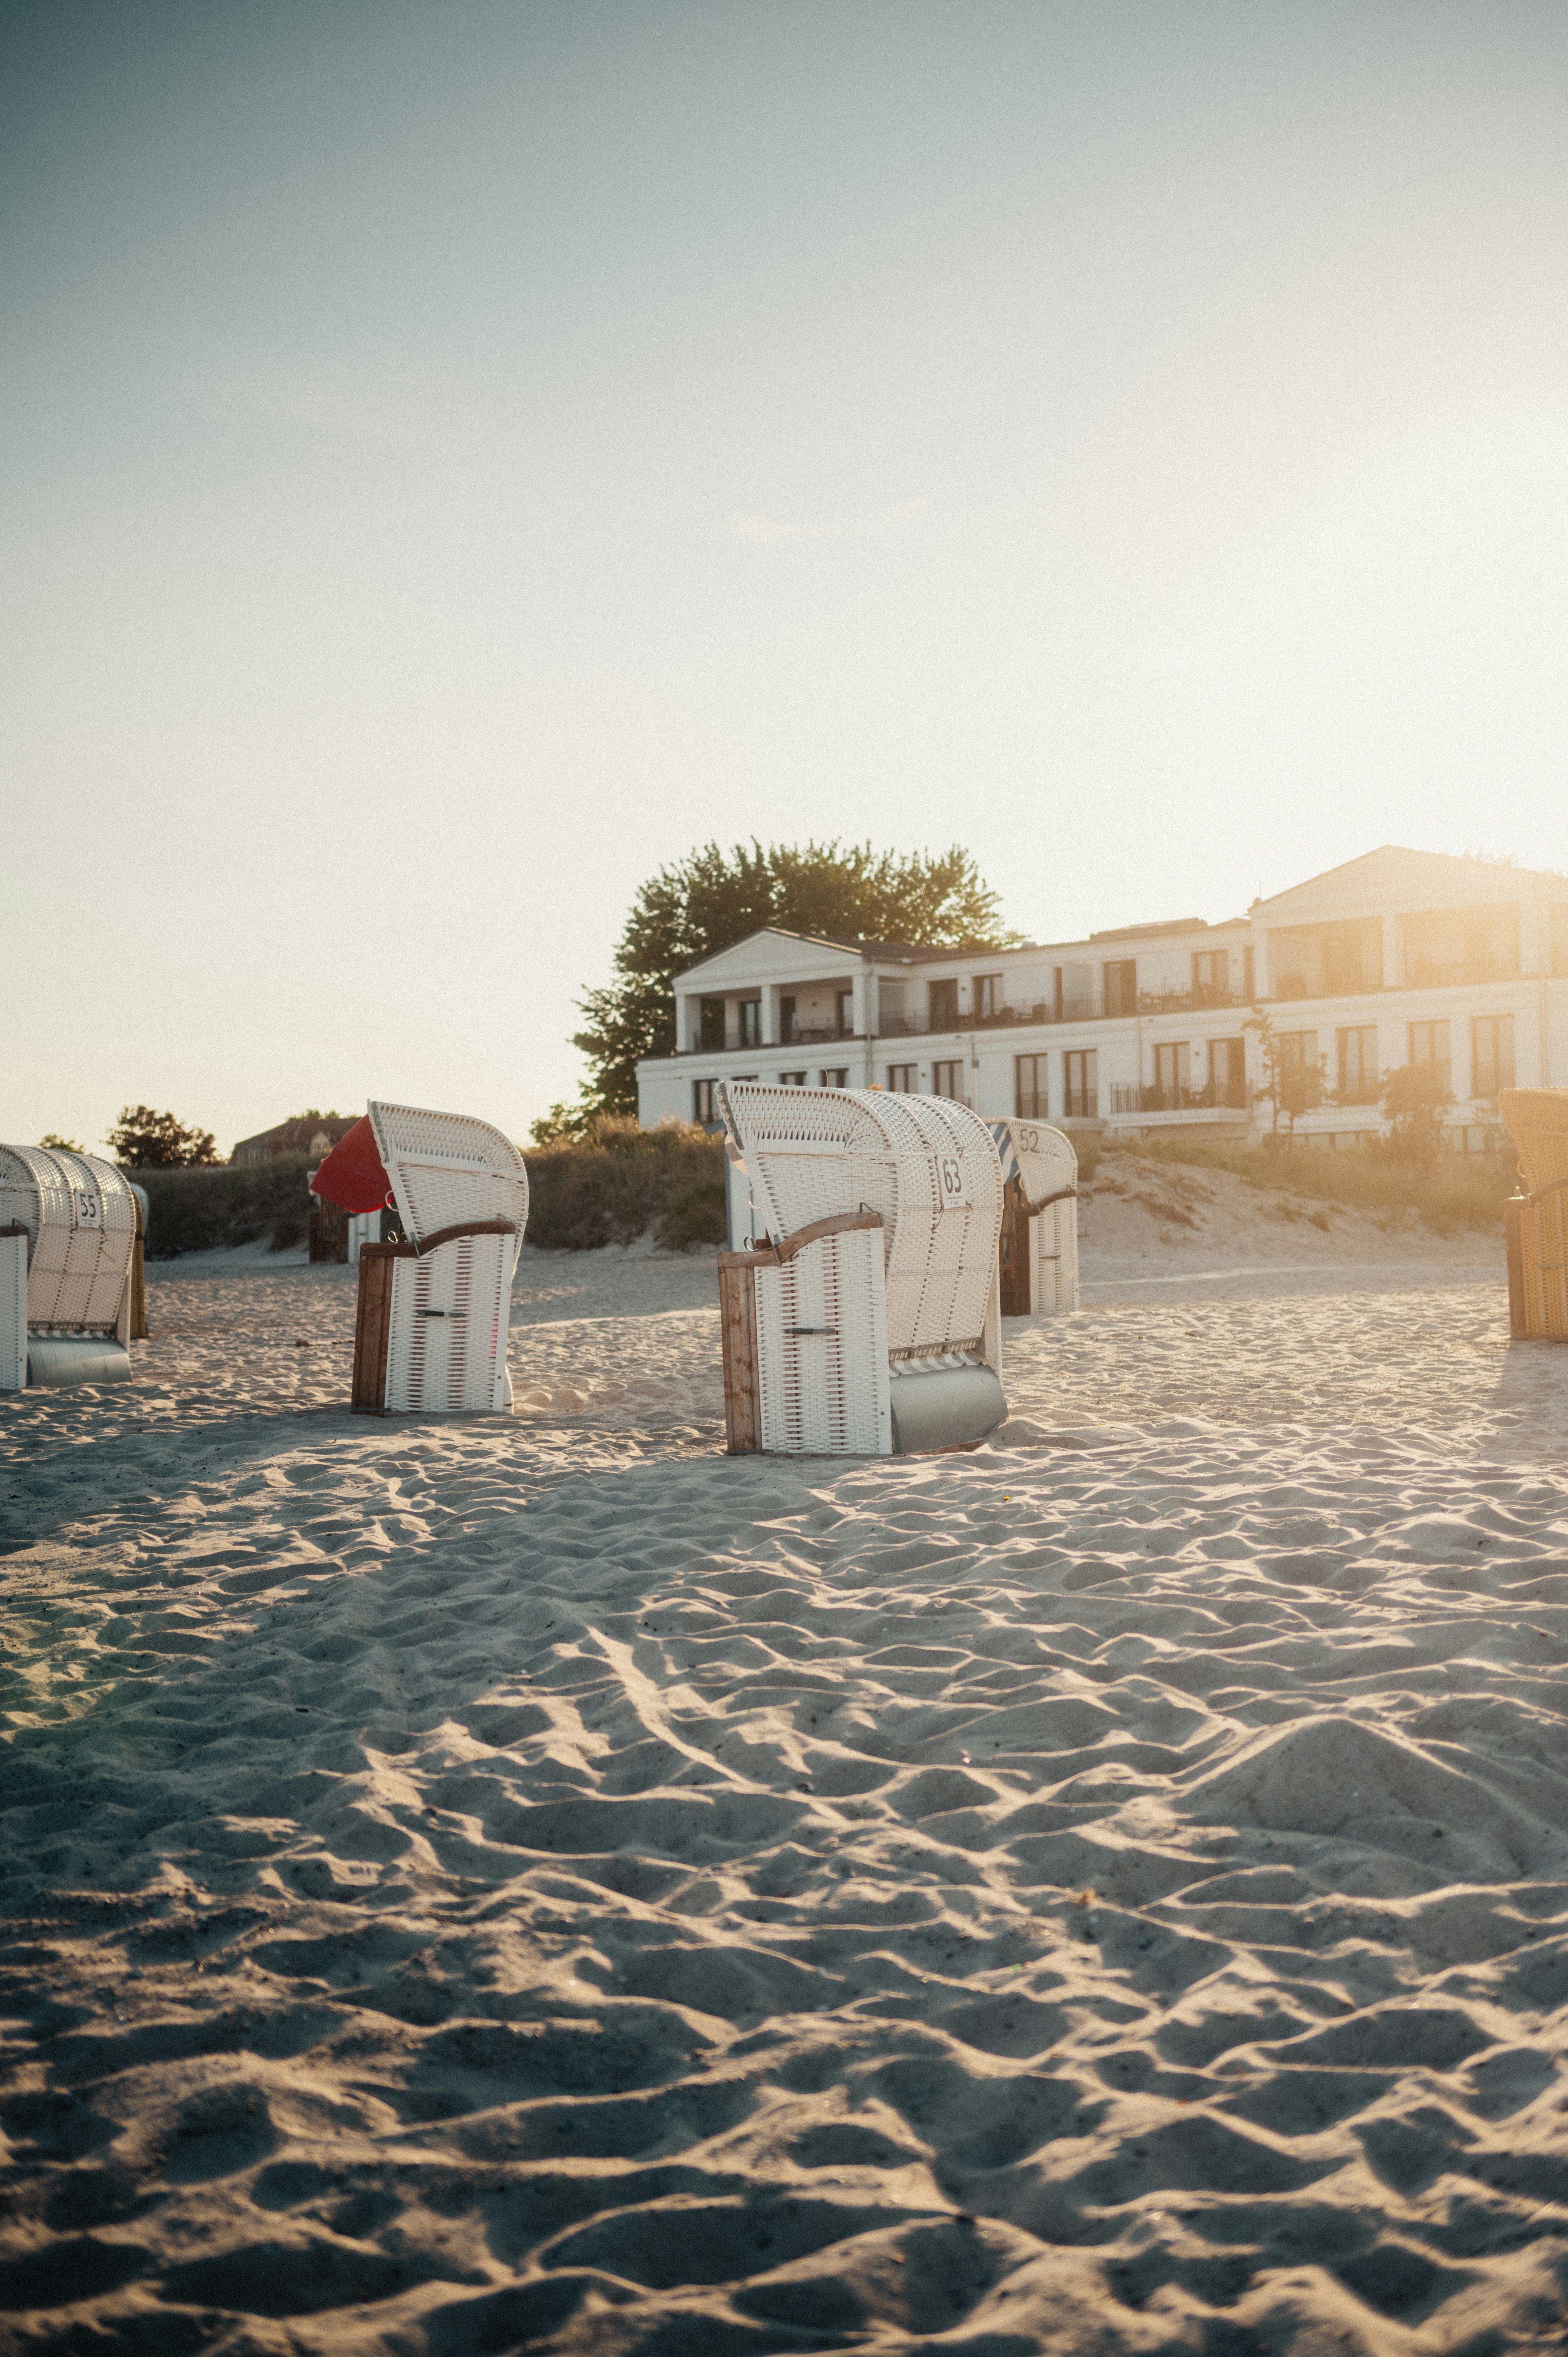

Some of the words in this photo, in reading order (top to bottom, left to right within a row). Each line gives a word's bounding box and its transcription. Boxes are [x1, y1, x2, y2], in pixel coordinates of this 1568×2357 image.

[1020, 1129, 1040, 1153] 52
[943, 1159, 962, 1193] 63
[80, 1193, 96, 1218] 55
